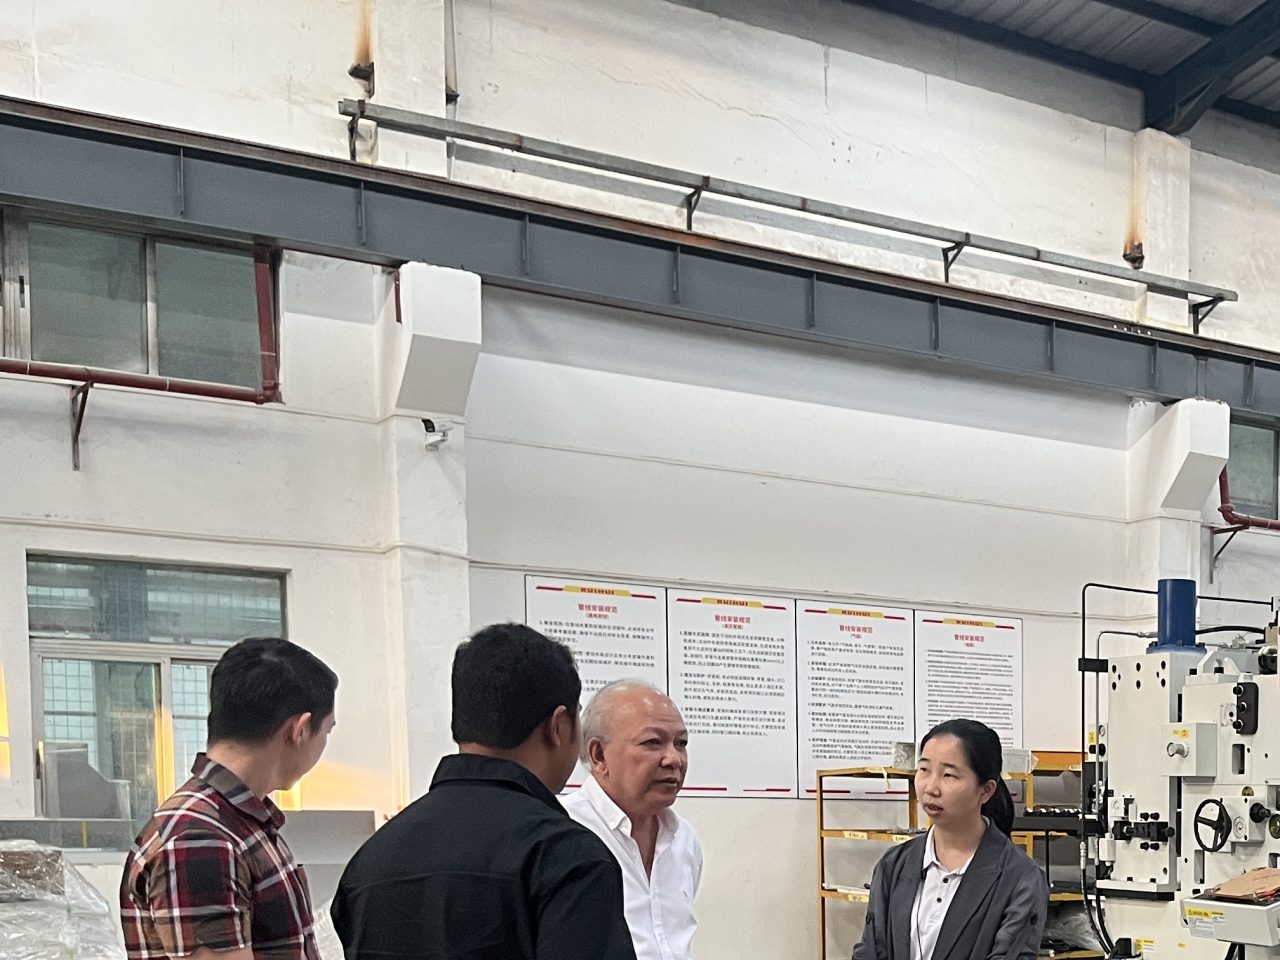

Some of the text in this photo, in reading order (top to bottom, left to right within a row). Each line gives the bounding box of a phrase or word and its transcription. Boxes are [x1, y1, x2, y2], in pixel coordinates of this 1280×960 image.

[580, 587, 615, 595] RUIHUI
[716, 599, 749, 607] RUIHUI
[841, 609, 871, 617] RUIHUI
